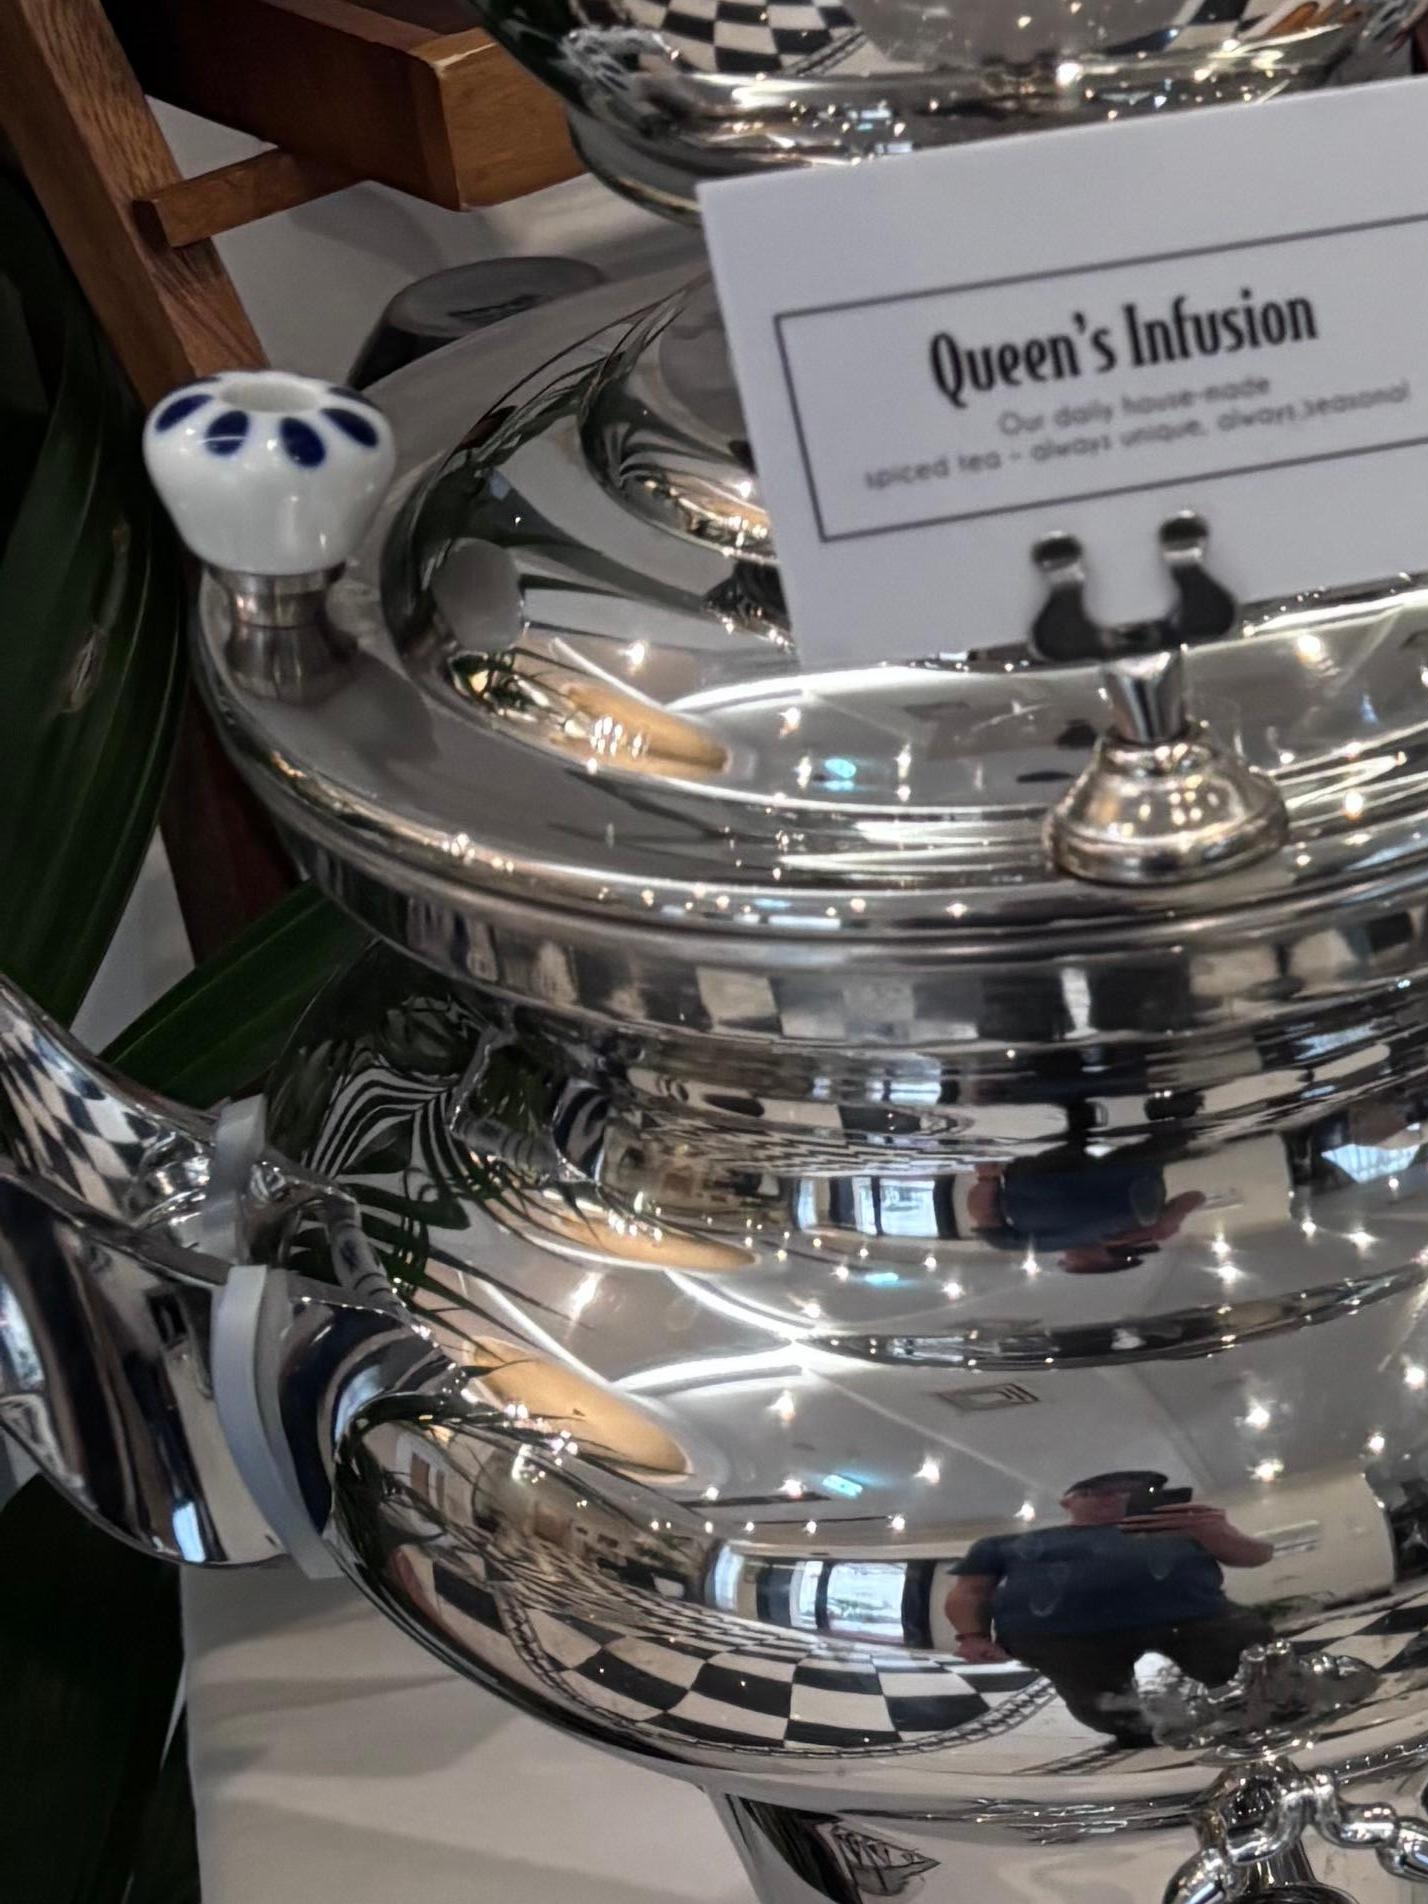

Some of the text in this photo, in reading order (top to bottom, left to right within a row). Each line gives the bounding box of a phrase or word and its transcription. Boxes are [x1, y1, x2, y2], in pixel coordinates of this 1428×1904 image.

[930, 287, 1318, 409] Queen's Infusion
[864, 457, 950, 490] spiced
[957, 450, 1002, 473] tea
[1030, 435, 1112, 463] always
[1301, 377, 1411, 419] seasonal
[998, 411, 1044, 436] Our
[1053, 399, 1113, 430] daily
